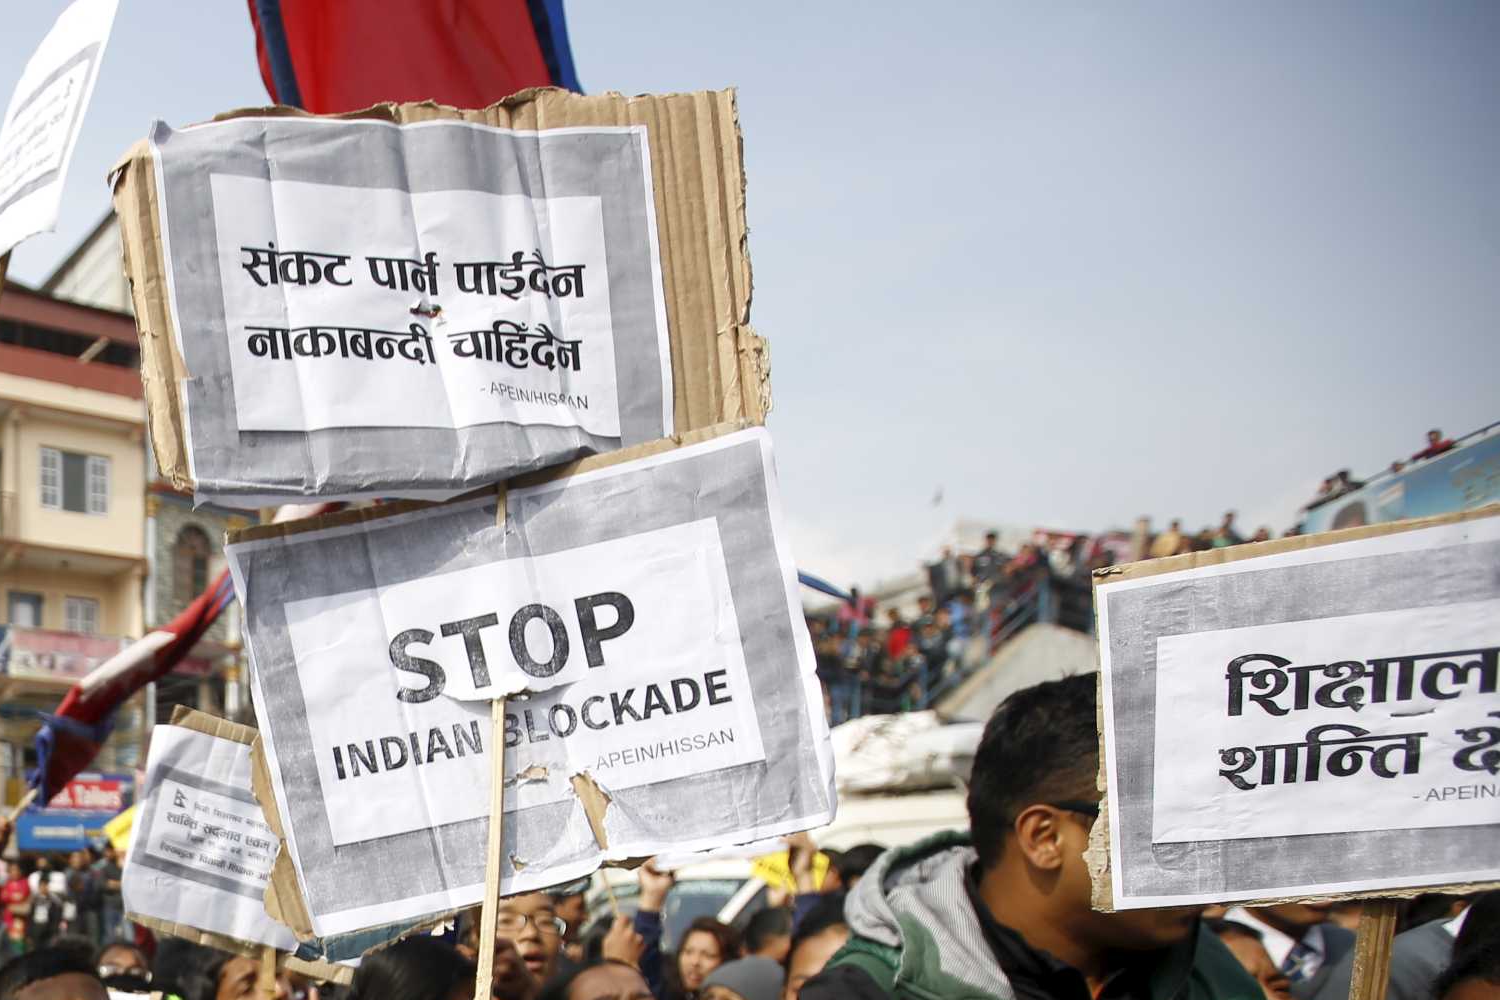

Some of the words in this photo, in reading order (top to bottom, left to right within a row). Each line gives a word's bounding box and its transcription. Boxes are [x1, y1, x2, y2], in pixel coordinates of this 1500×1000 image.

[240, 241, 352, 287] संकट
[244, 322, 437, 366] नाकाबन्दी
[490, 381, 589, 410] APEIN/HISSAN
[389, 590, 636, 704] STOP
[332, 720, 484, 781] INDIAN
[504, 669, 733, 749] BLOCKADE
[596, 728, 736, 770] APEIN/HISSAN
[1218, 724, 1428, 791] शान्ति
